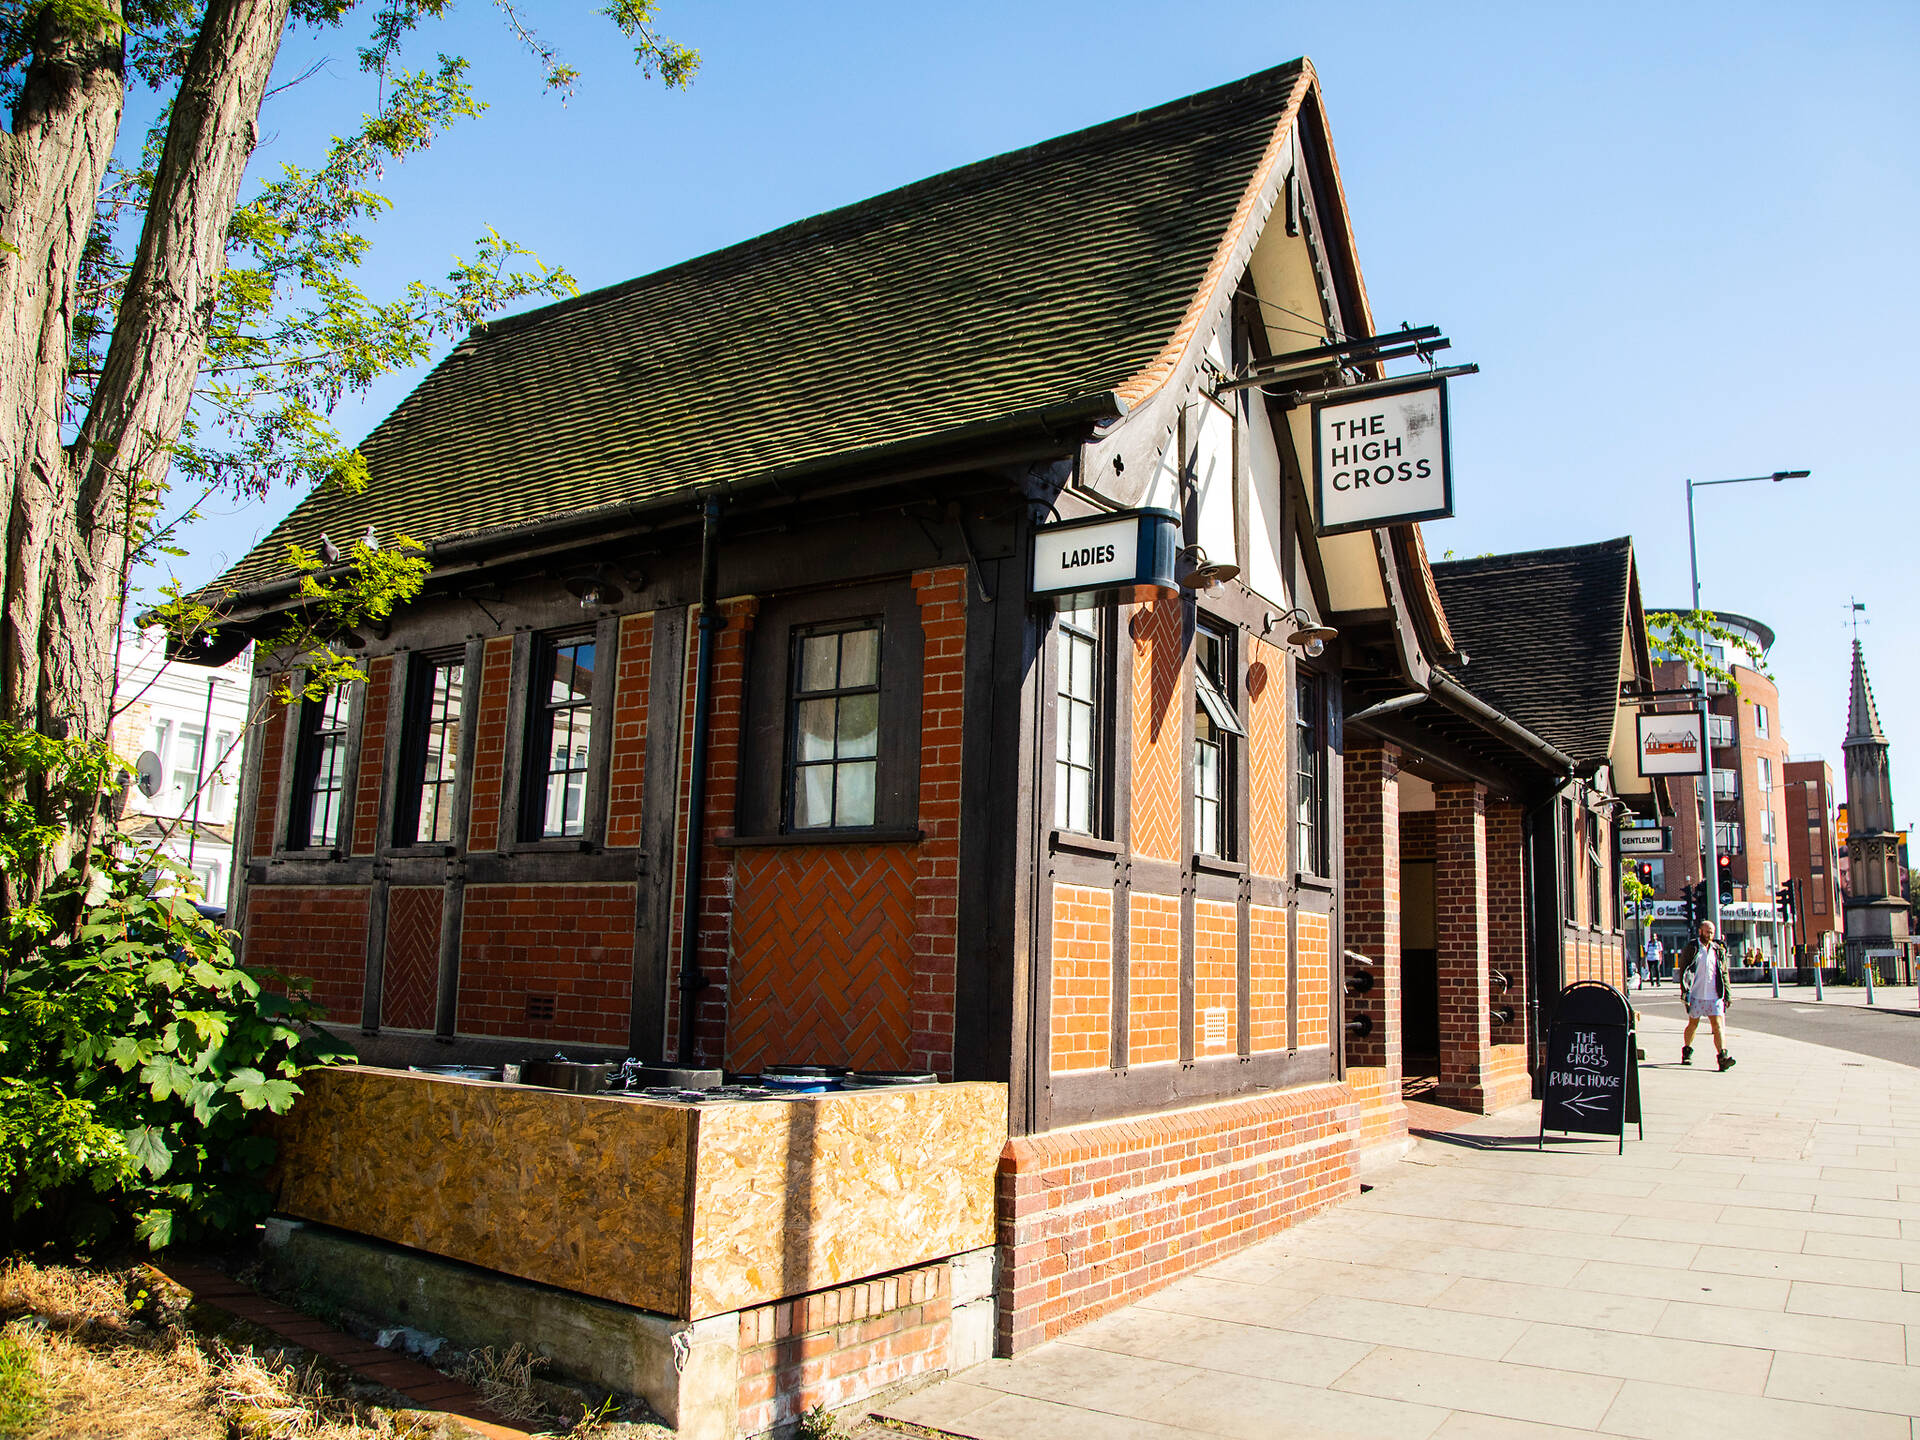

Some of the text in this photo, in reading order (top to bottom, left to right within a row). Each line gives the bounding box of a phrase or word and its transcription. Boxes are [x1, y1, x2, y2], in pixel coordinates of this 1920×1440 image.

[1331, 414, 1385, 441] THE
[1331, 437, 1401, 467] HIGH
[1332, 458, 1431, 492] CROSS
[1062, 544, 1115, 569] LADIES
[1622, 836, 1660, 845] GENTLEMEN
[1575, 1031, 1597, 1044] THE
[1570, 1042, 1605, 1057] HIGH
[1567, 1053, 1609, 1067] CROSS
[1549, 1071, 1621, 1088] PUBLIC HOUSE
